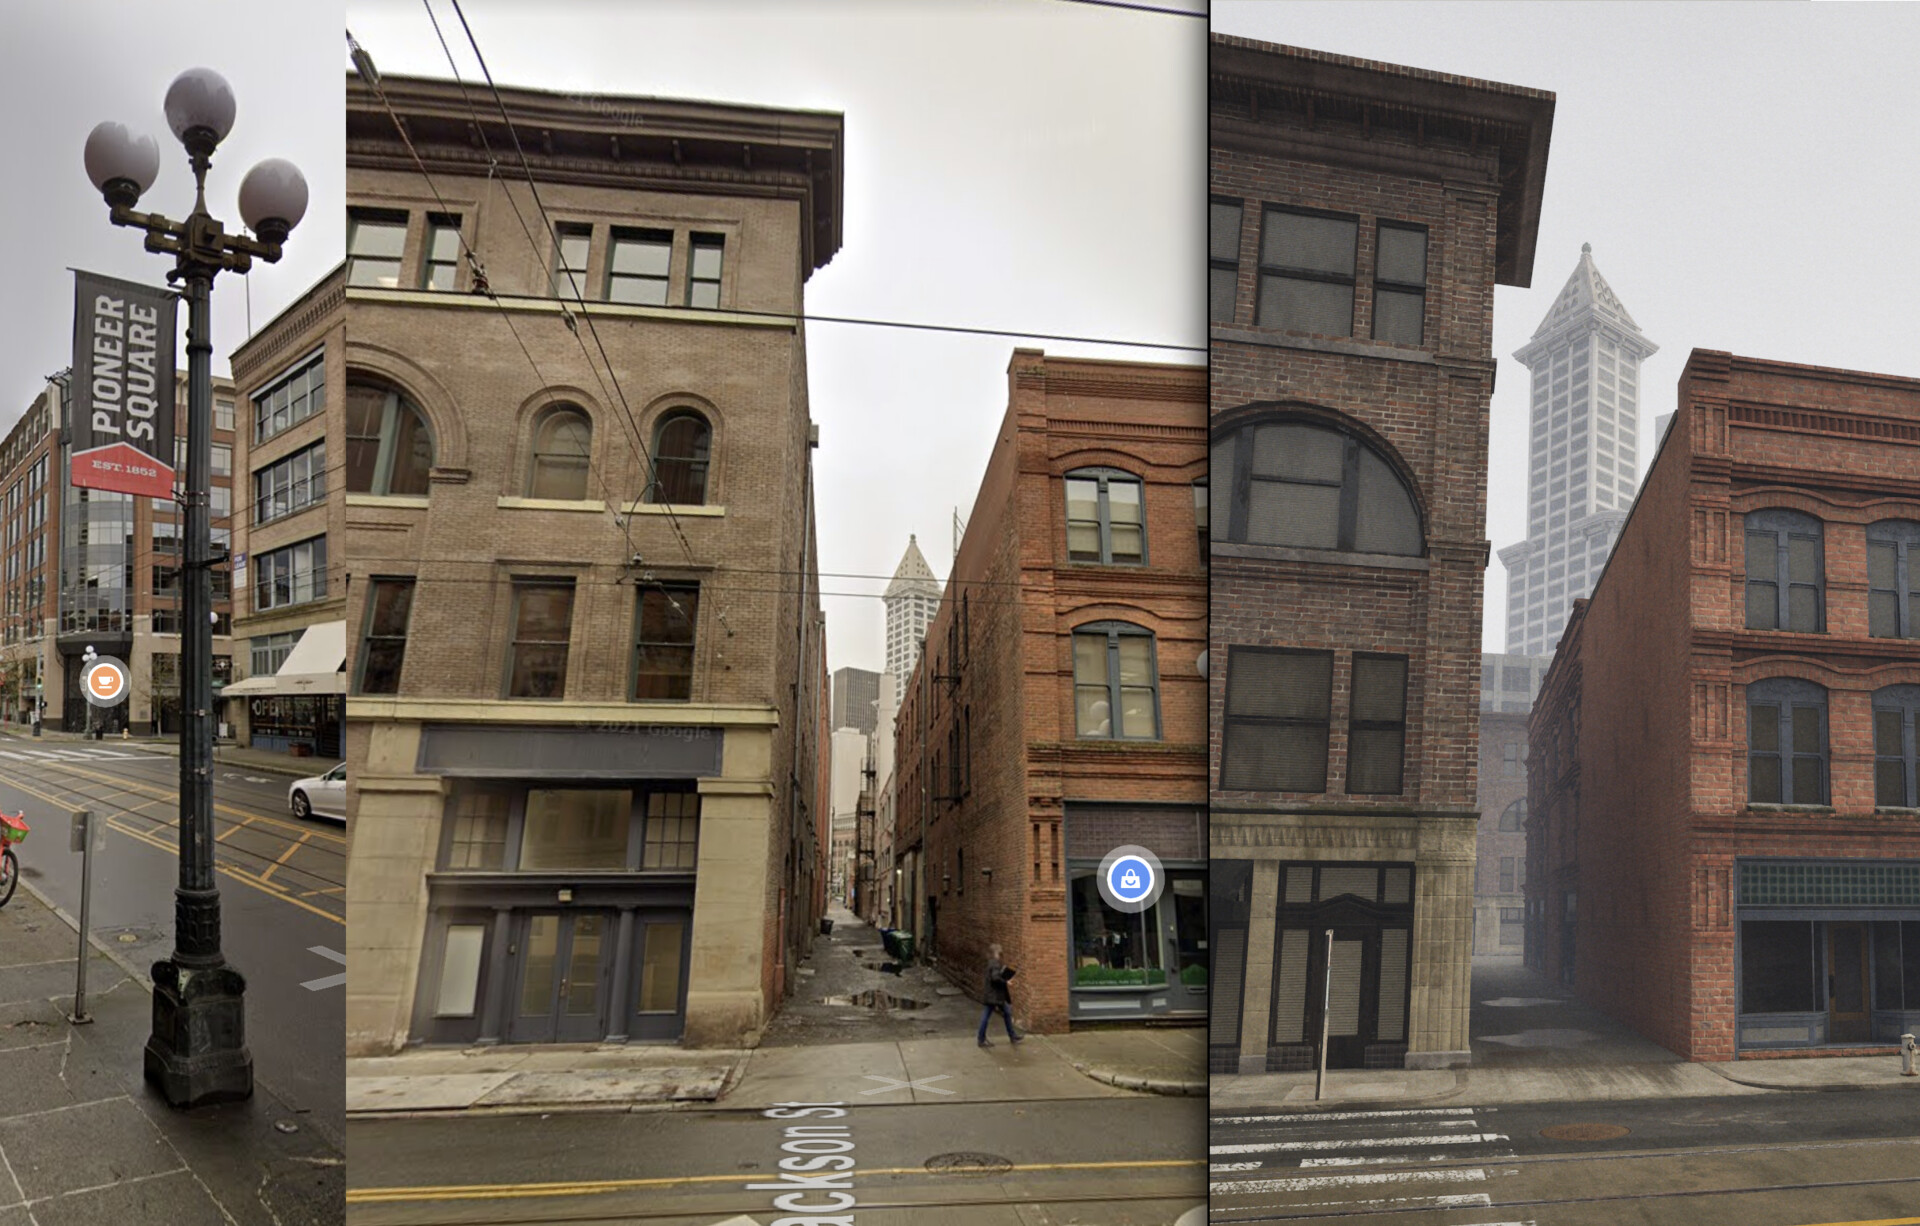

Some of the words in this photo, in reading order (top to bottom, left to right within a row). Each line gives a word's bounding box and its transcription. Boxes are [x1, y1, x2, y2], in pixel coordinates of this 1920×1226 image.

[92, 295, 124, 435] PIONEER
[126, 303, 158, 441] SQUARE
[126, 465, 157, 477] 1852
